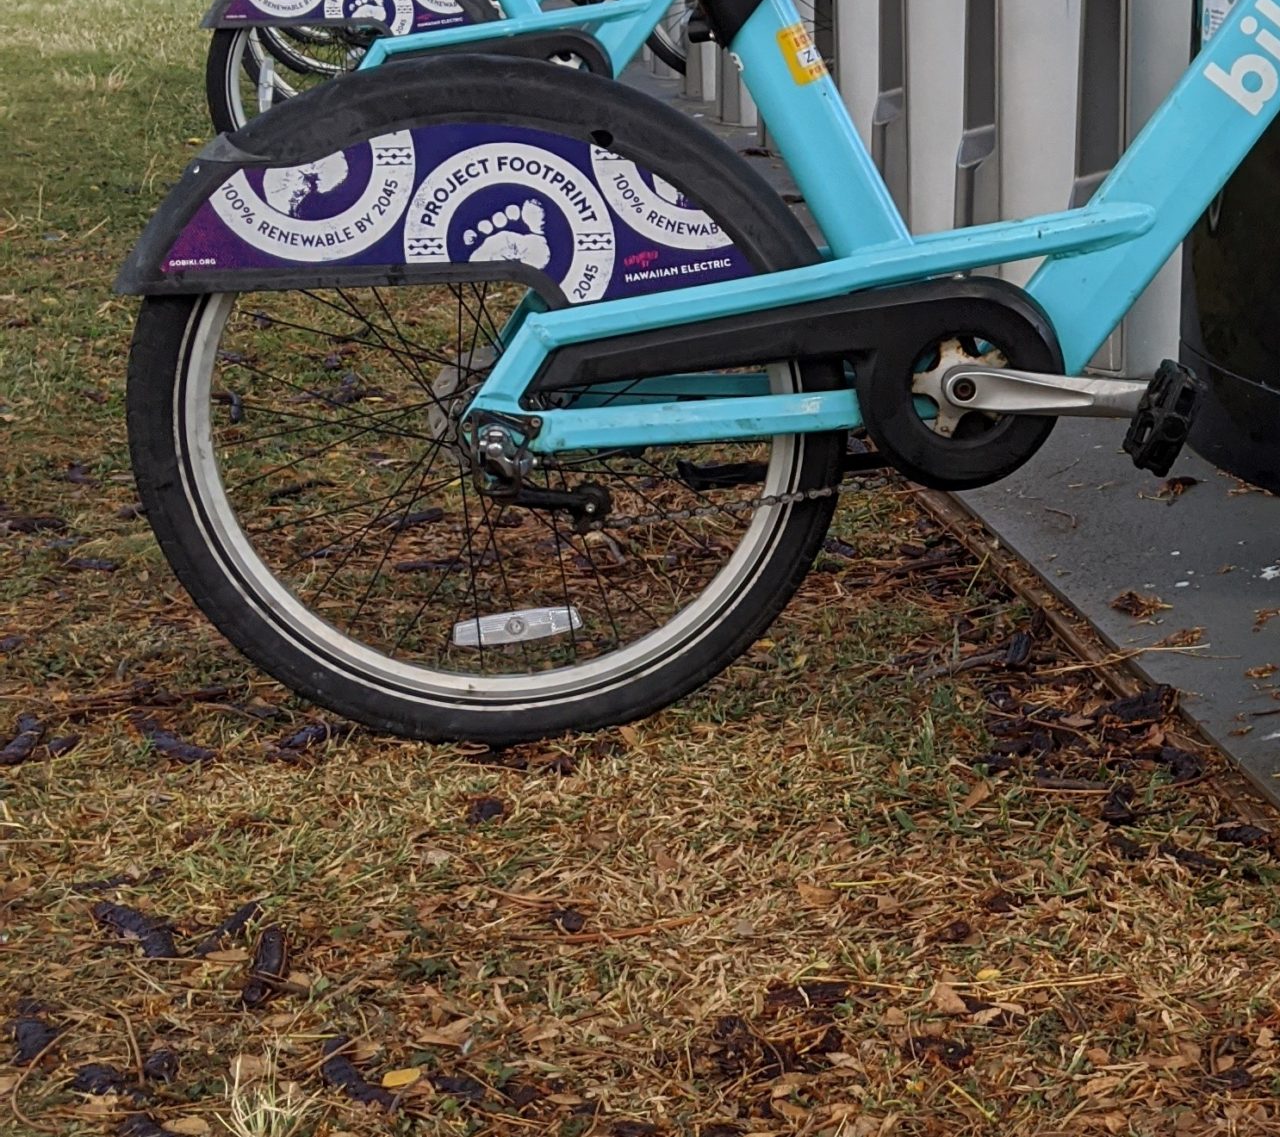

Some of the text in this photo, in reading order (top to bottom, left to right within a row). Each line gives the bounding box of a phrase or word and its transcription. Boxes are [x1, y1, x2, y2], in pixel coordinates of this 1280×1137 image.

[263, 0, 303, 11] RENEWABLE
[420, 156, 598, 227] PROJECT FOOTPRINT
[613, 173, 646, 214] 100%
[221, 179, 399, 248] 100% RENEWABLE BY 2045
[169, 258, 216, 266] GOBIKI.ORG
[624, 258, 732, 283] HAWAIIAN ELECTRIC
[573, 264, 599, 299] 2045
